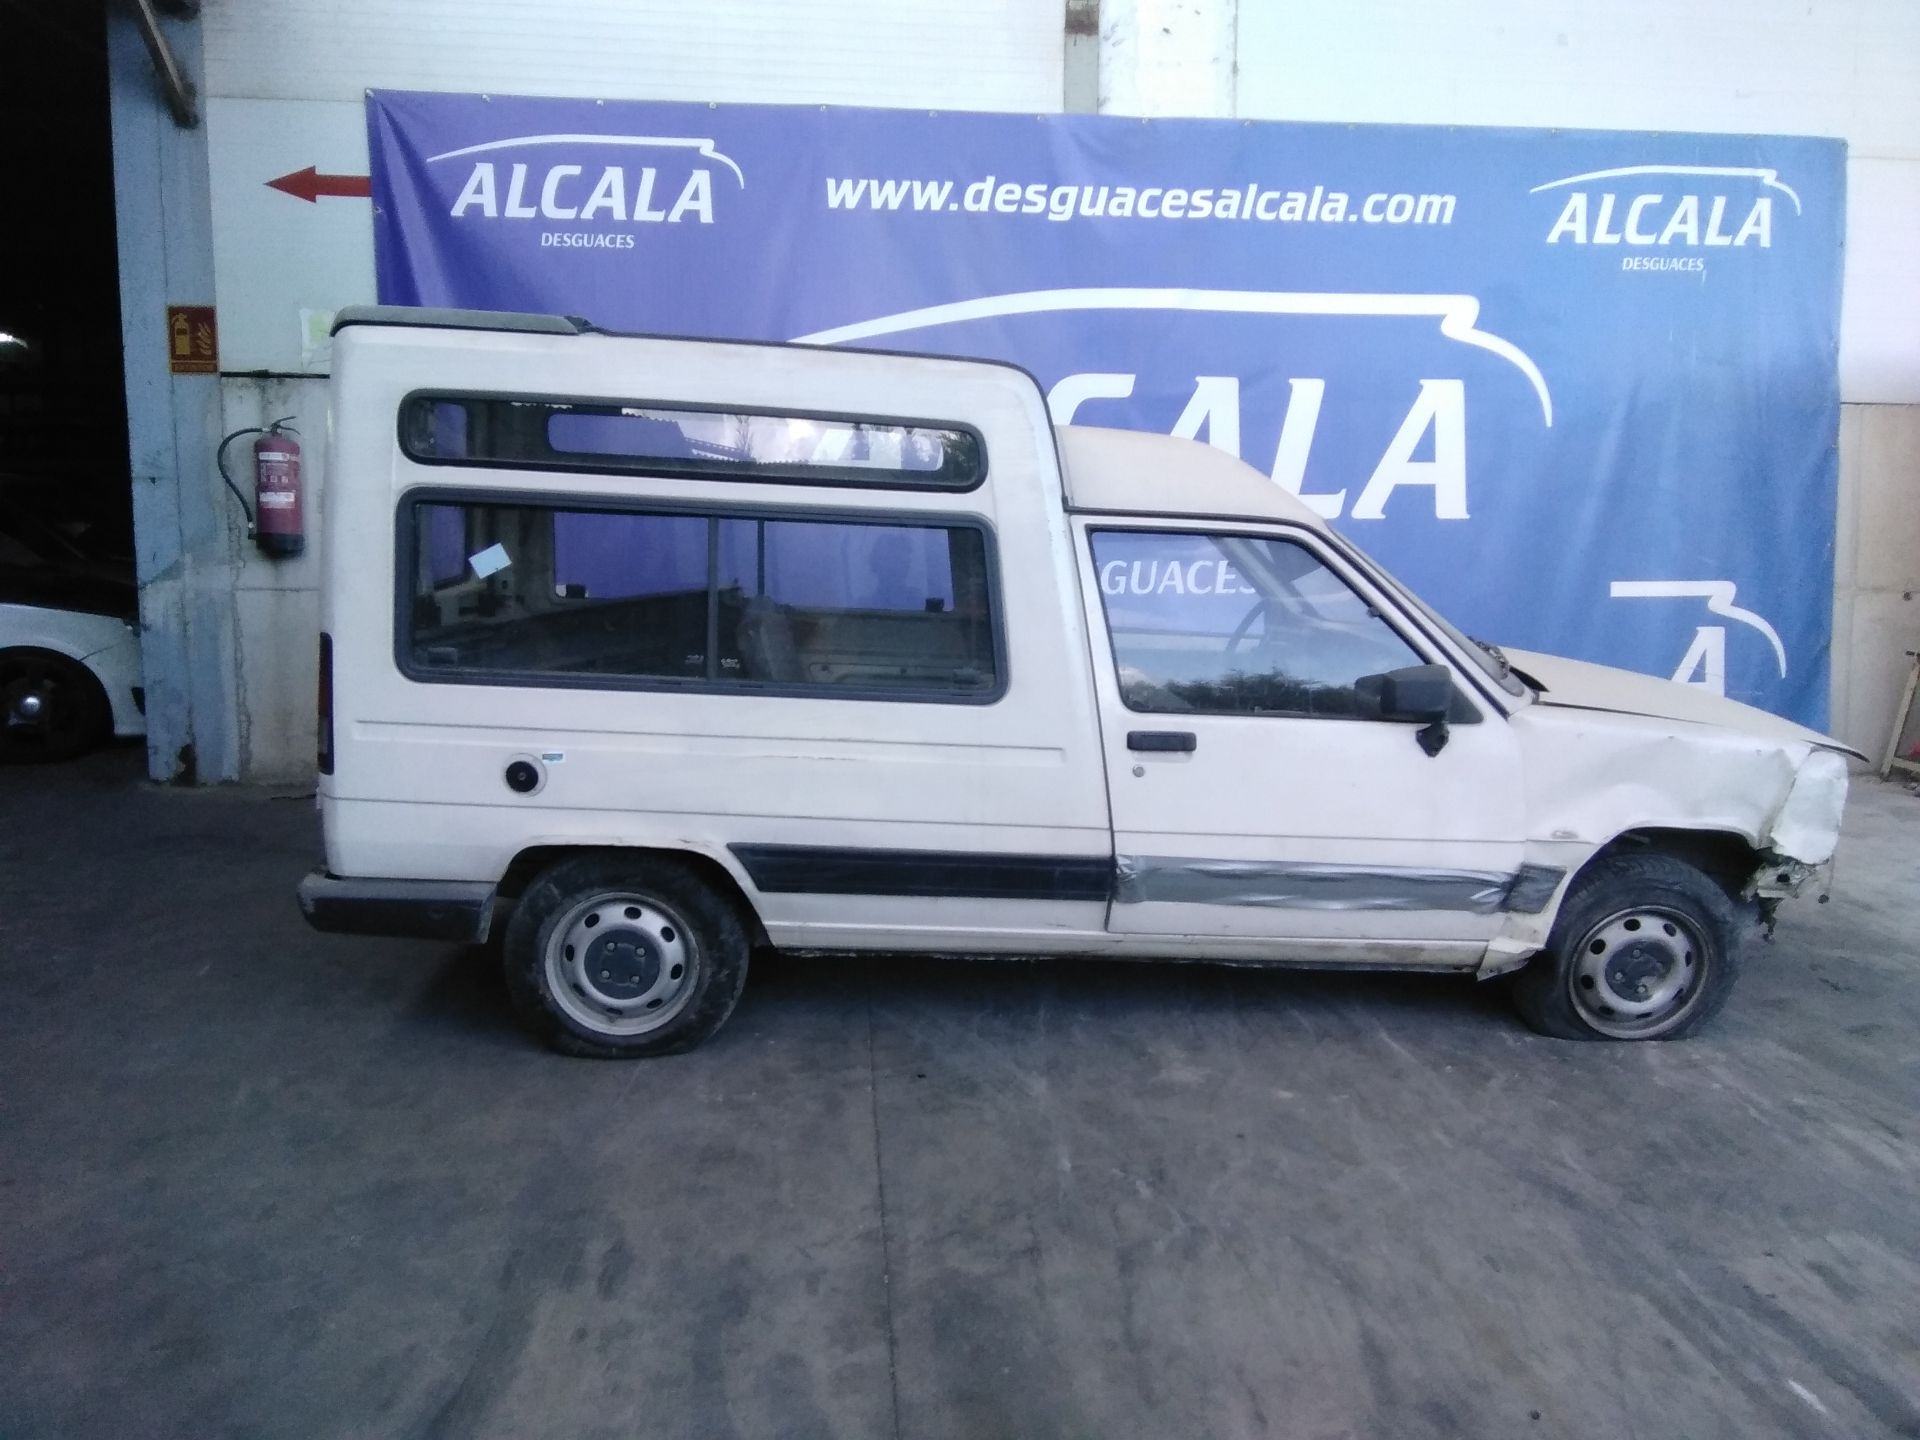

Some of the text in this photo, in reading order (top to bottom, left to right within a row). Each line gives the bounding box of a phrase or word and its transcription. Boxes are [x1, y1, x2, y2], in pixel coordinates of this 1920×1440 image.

[450, 162, 715, 224] ALCALA
[826, 175, 1457, 224] www.desguacesalcala.com
[541, 232, 635, 249] DESGUACES
[1546, 192, 1772, 248] ALCALA
[1622, 257, 1705, 272] DESGUACES
[1100, 560, 1257, 595] GUACE
